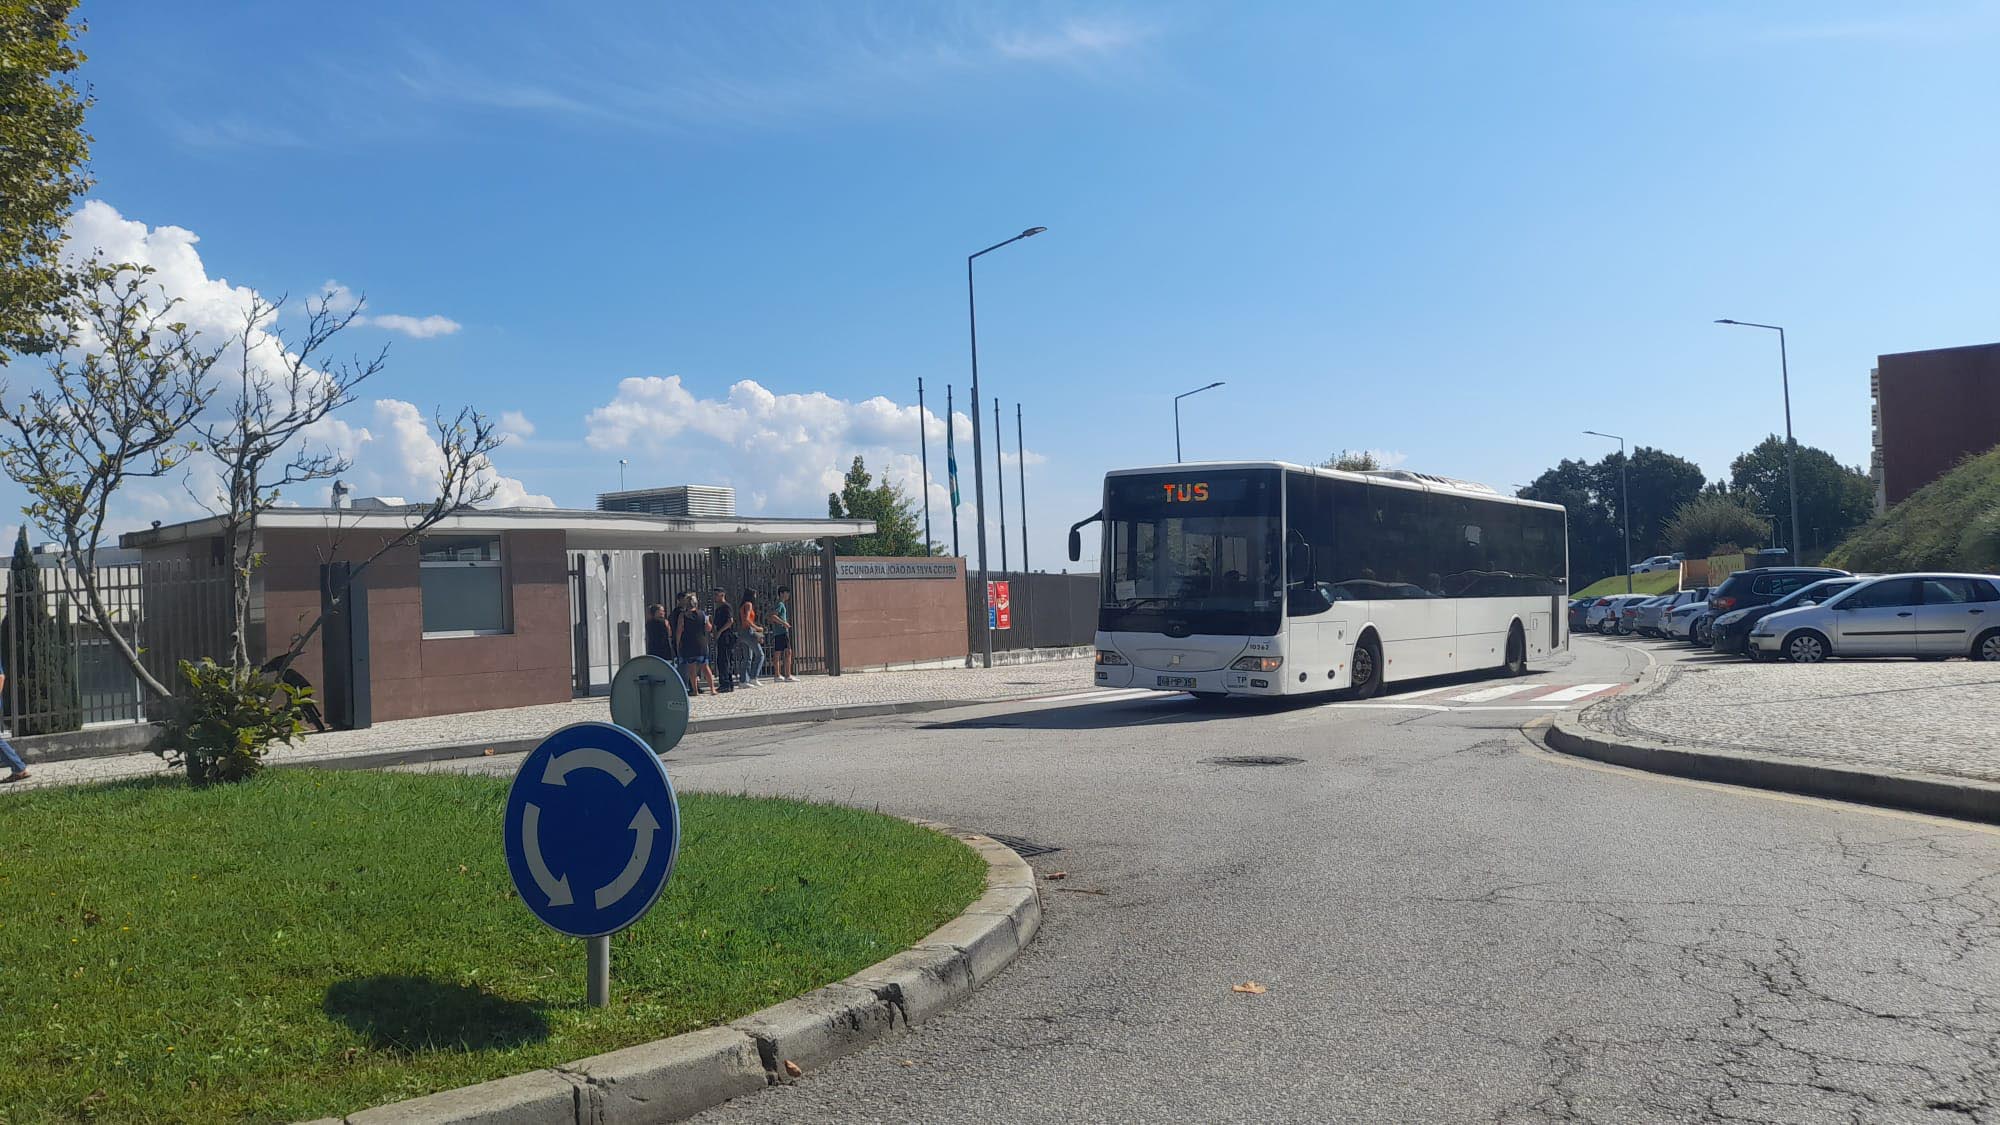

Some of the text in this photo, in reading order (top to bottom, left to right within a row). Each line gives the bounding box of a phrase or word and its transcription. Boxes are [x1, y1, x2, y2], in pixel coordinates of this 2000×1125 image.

[1163, 482, 1208, 503] TUS
[841, 563, 886, 575] SECUNDÁRIA
[887, 563, 906, 575] JOÃO
